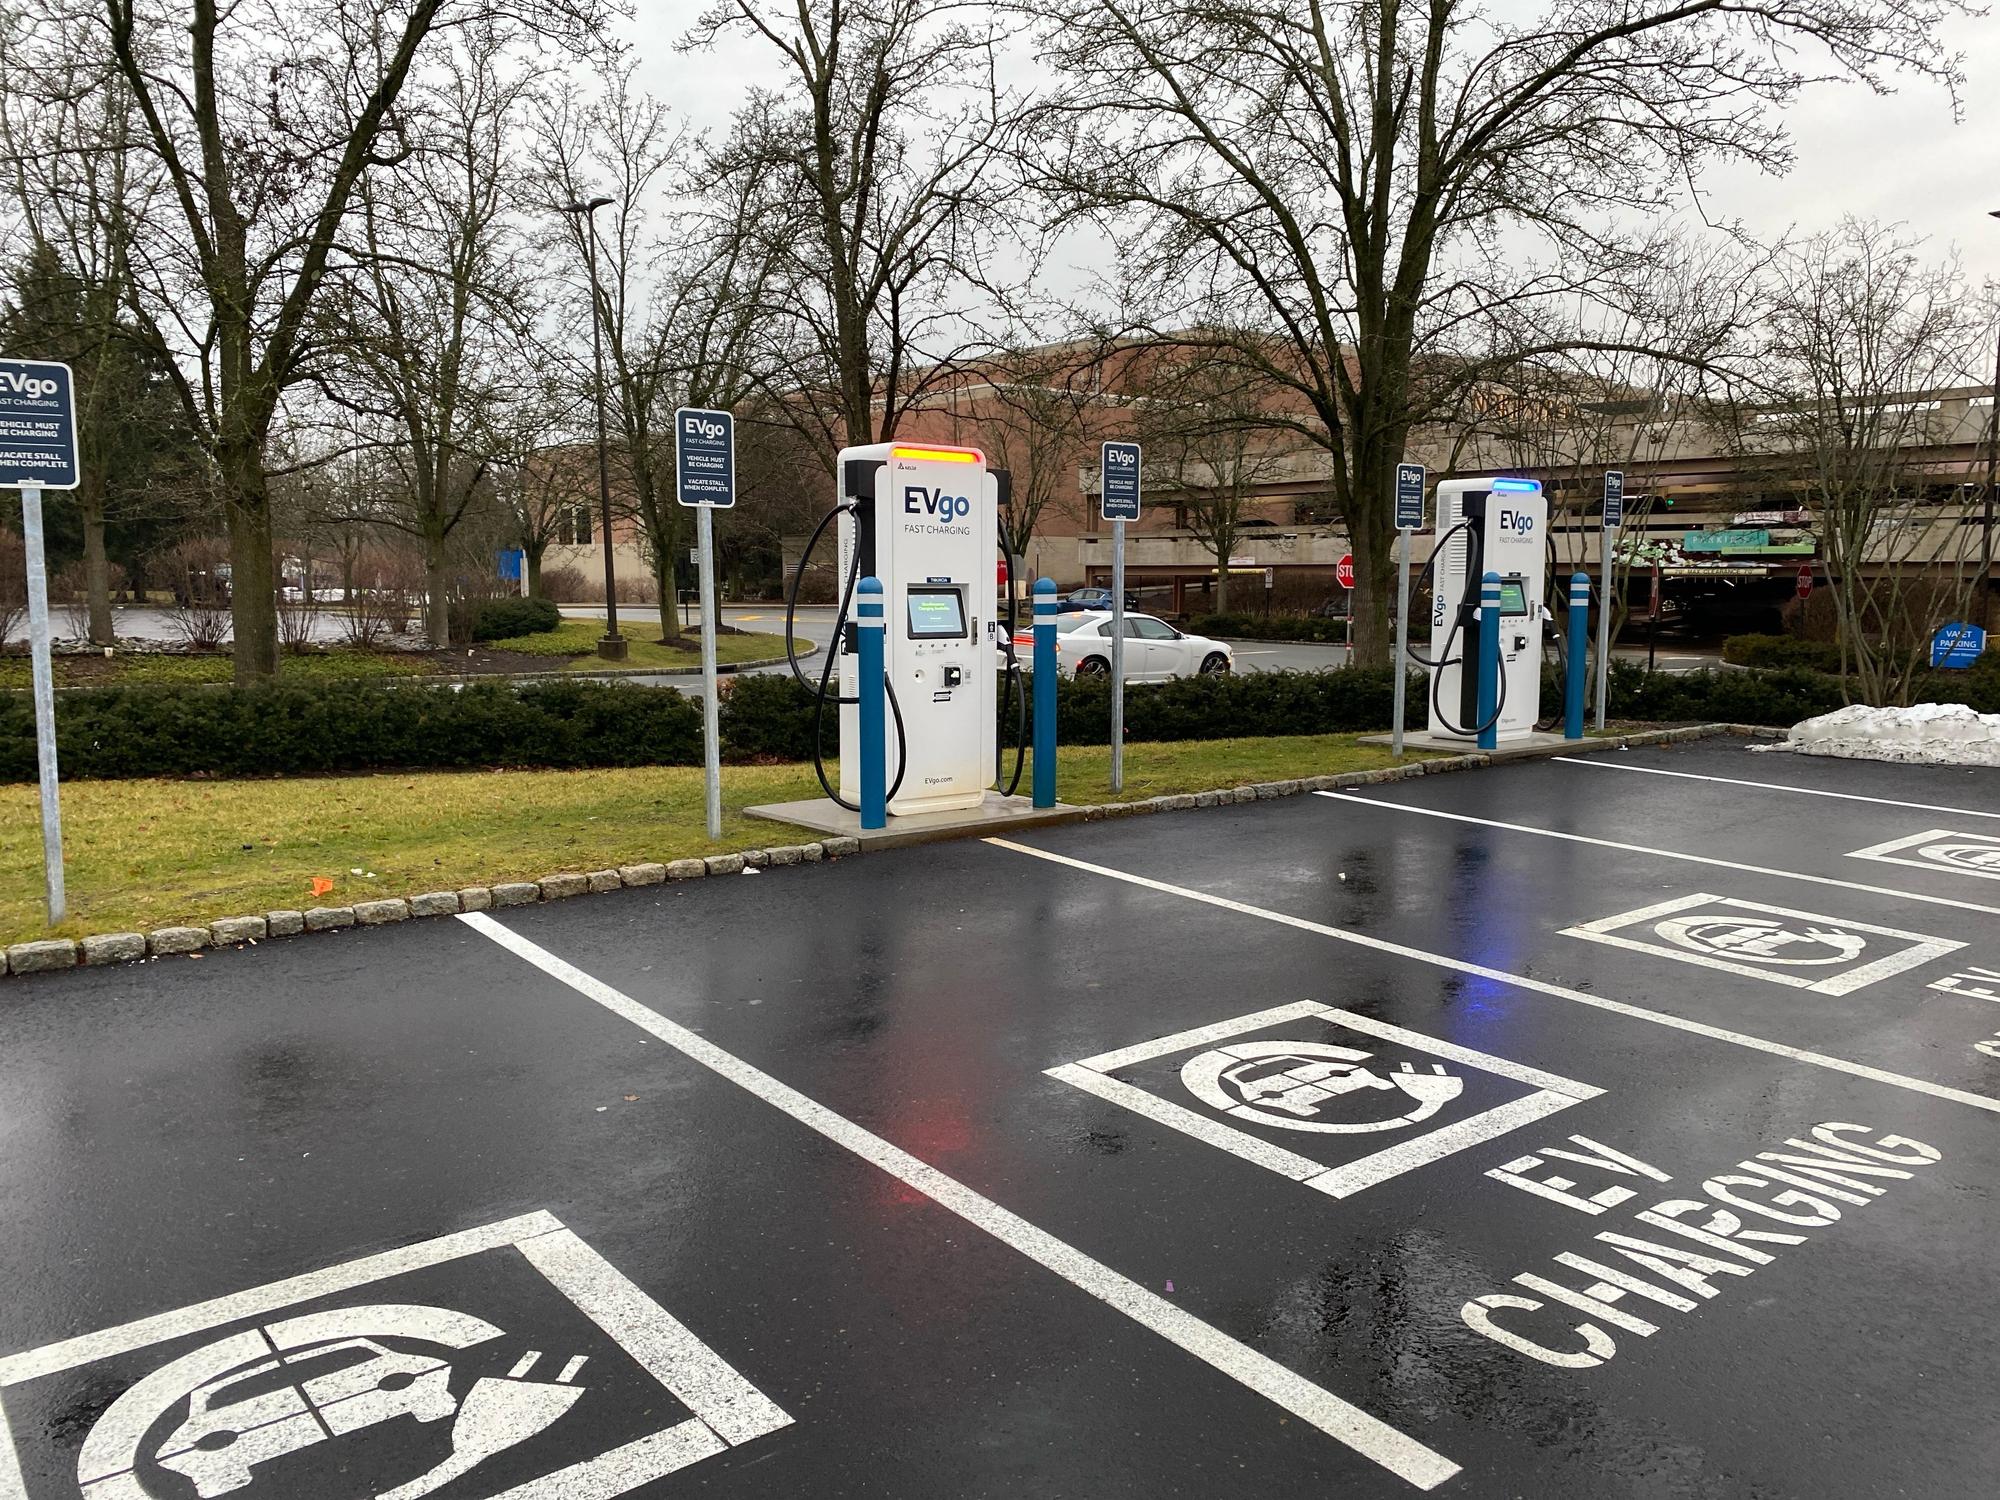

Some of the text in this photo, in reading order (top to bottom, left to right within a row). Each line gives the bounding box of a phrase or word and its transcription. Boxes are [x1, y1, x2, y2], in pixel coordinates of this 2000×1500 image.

[13, 399, 59, 408] CHARGING
[0, 420, 60, 430] EHICLE MUST
[685, 418, 725, 439] EVgo
[10, 429, 58, 438] CHARGING
[0, 459, 69, 468] HEN COMPLETE
[34, 453, 61, 461] STALL
[1108, 450, 1135, 466] EVgo
[1401, 470, 1421, 484] EVgo
[1608, 476, 1621, 489] EVgo
[905, 486, 970, 523] EVgo
[904, 524, 970, 535] FAST CHARGING
[1500, 510, 1533, 536] EVgo
[1499, 536, 1510, 544] FAST
[1338, 564, 1354, 578] ST
[1798, 575, 1812, 588] STOP
[1433, 595, 1446, 627] EVgo
[924, 777, 953, 785] EVgo.com
[1483, 1134, 1673, 1216] EV
[1461, 1121, 1943, 1369] CHARGING
